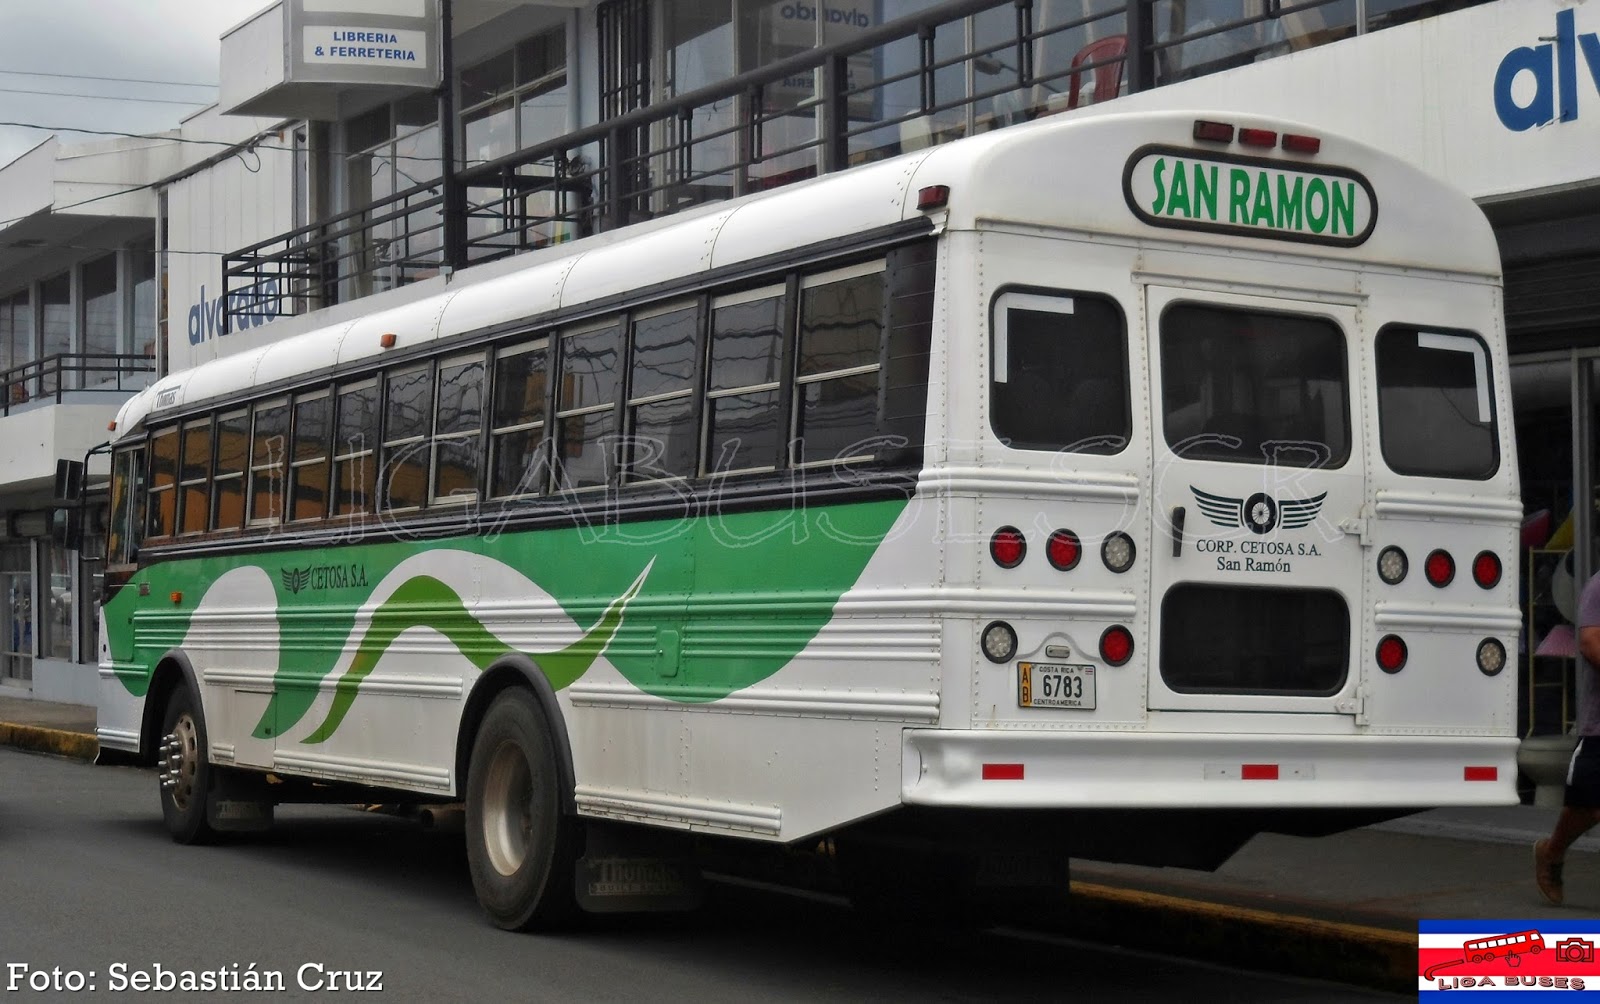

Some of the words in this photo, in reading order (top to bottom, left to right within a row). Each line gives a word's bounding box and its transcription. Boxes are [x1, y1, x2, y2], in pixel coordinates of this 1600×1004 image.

[333, 31, 398, 44] LIBRERIA
[314, 46, 325, 57] &
[330, 46, 416, 61] FERRETERIA
[1152, 157, 1219, 221] SAN
[1229, 168, 1355, 236] RAMON
[1196, 539, 1238, 554] CORP.
[1240, 540, 1295, 556] CETOSA
[1297, 542, 1322, 557] S.A.
[1216, 556, 1241, 572] San
[1244, 557, 1291, 573] Ramón
[311, 565, 349, 590] CETOSA
[350, 563, 369, 588] S.A.
[1039, 666, 1059, 674] COSTA
[1043, 674, 1083, 699] 6783
[1033, 698, 1082, 707] CENTROAMERICA
